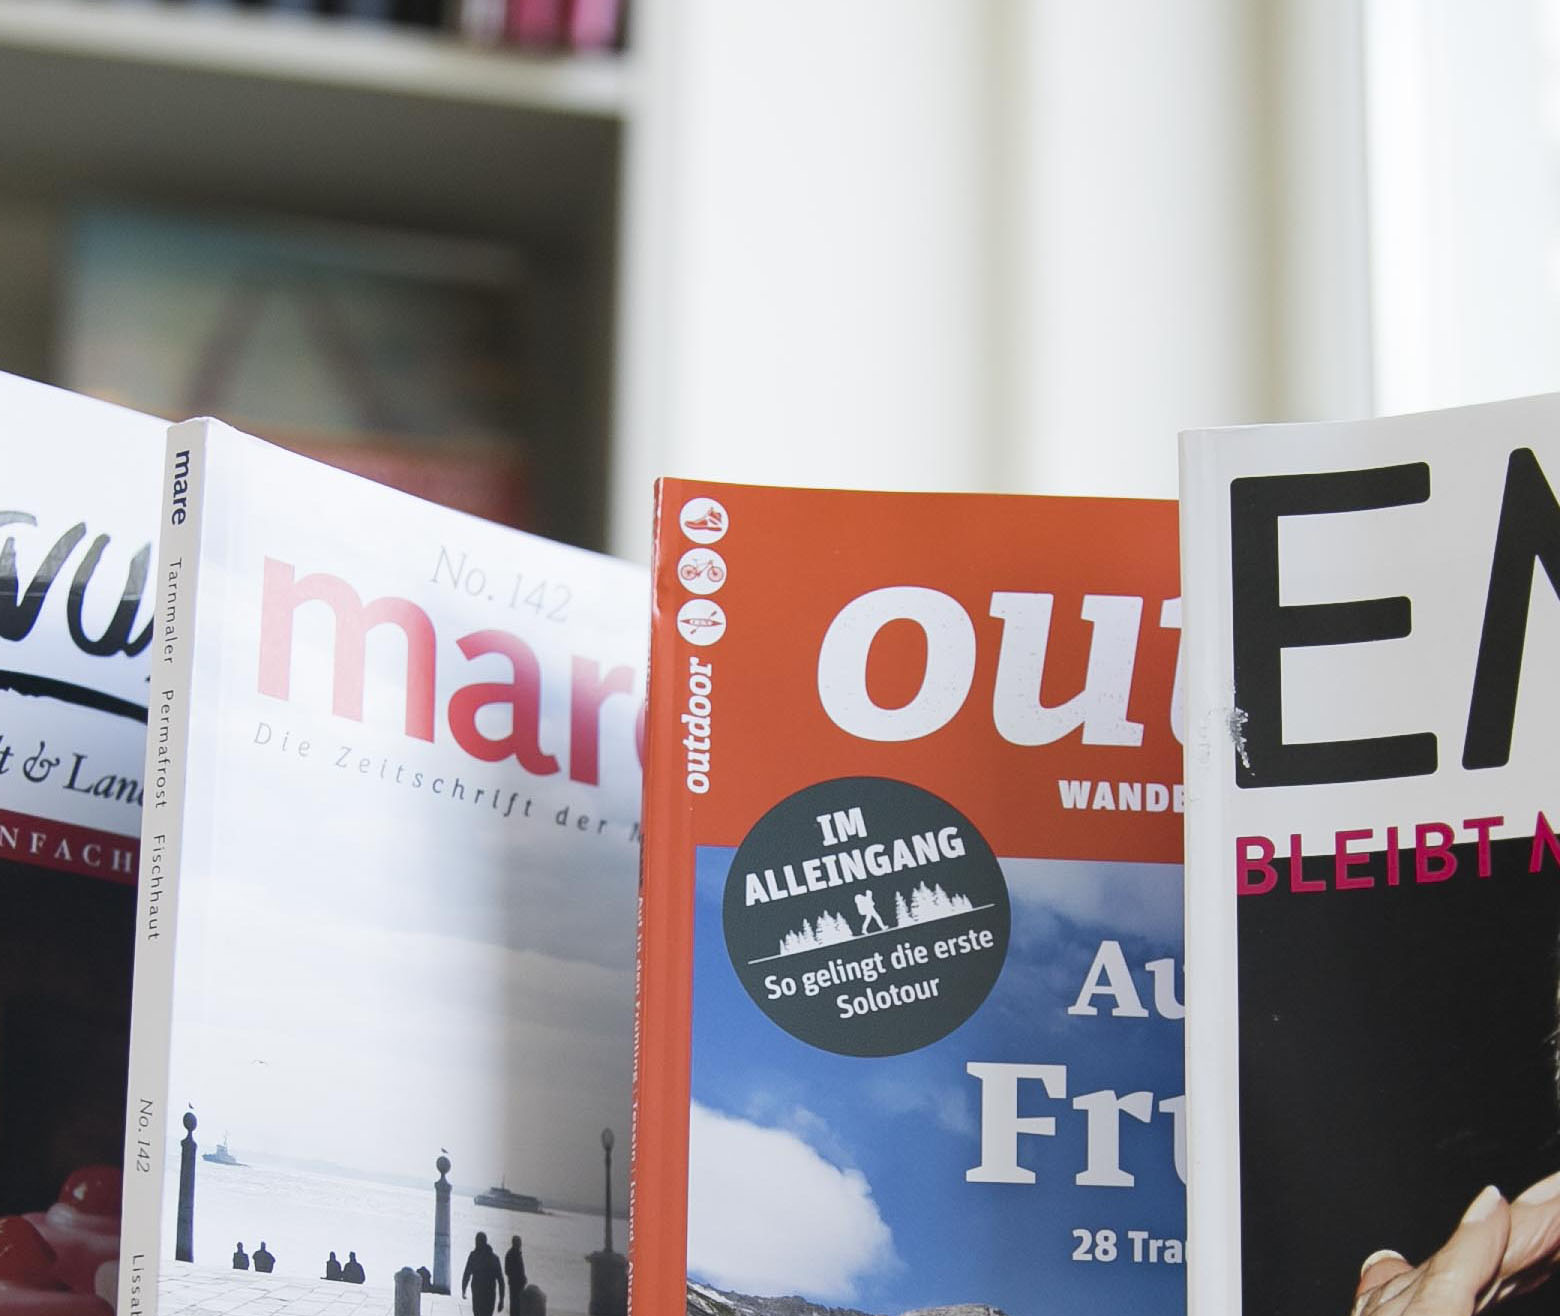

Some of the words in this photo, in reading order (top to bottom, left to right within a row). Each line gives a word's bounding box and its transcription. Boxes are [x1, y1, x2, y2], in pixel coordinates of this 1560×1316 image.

[171, 450, 190, 526] mare
[163, 556, 182, 665] Tarnmaler
[430, 545, 495, 601] No.
[507, 573, 574, 624] 142
[257, 554, 646, 787] mar
[23, 741, 60, 783] &
[154, 690, 174, 808] Permafrost
[681, 657, 713, 794] outdoor
[253, 722, 313, 758] Die
[334, 746, 533, 817] Zeitschrift
[555, 806, 608, 834] der
[745, 826, 966, 907] ALLEINGANG
[816, 807, 868, 847] IM
[1235, 814, 1504, 896] BLEIBT
[147, 833, 166, 941] Fischhaut
[764, 975, 797, 1000] So
[801, 952, 887, 997] gelingt
[890, 942, 928, 970] die
[934, 929, 994, 959] erste
[837, 977, 940, 1019] Solotour
[136, 1099, 153, 1134] No.
[135, 1140, 151, 1174] 142
[1072, 1229, 1118, 1261] 28
